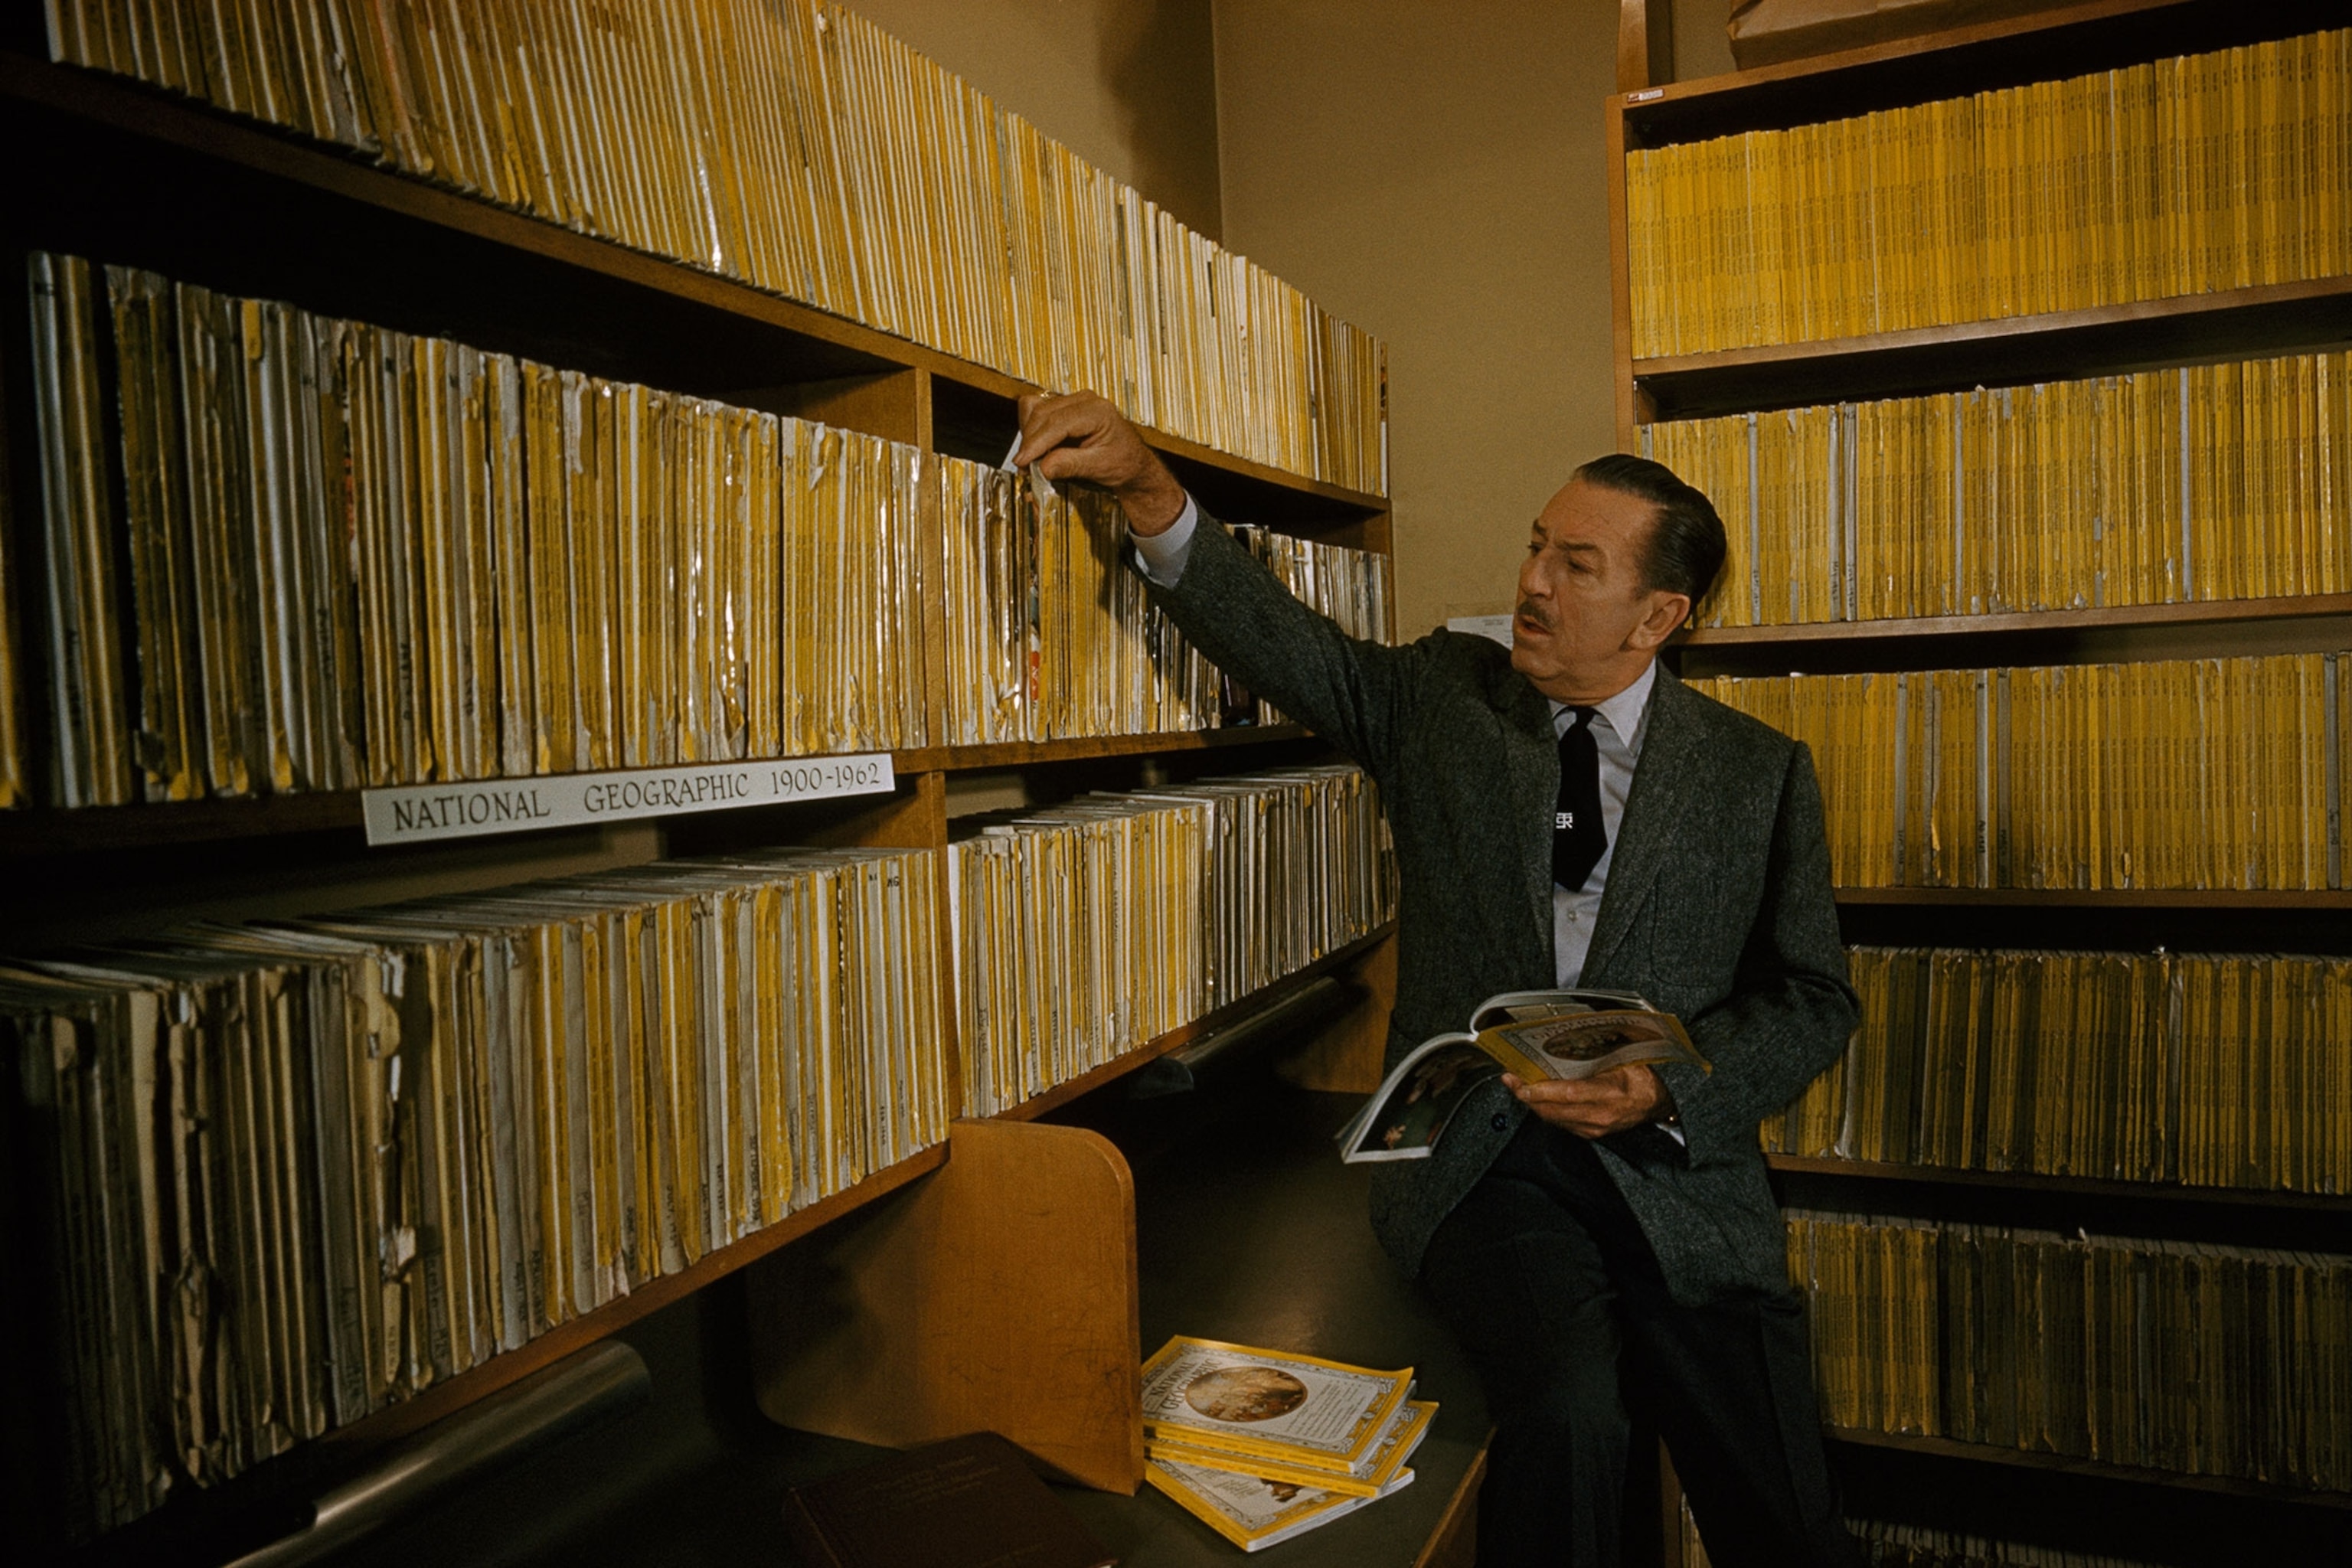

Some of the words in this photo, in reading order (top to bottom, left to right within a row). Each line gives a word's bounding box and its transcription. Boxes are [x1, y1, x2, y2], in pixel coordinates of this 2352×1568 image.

[392, 789, 551, 831] NATIONAL
[583, 773, 750, 813] GEOGRAPHIC
[770, 762, 881, 795] 1900-1962
